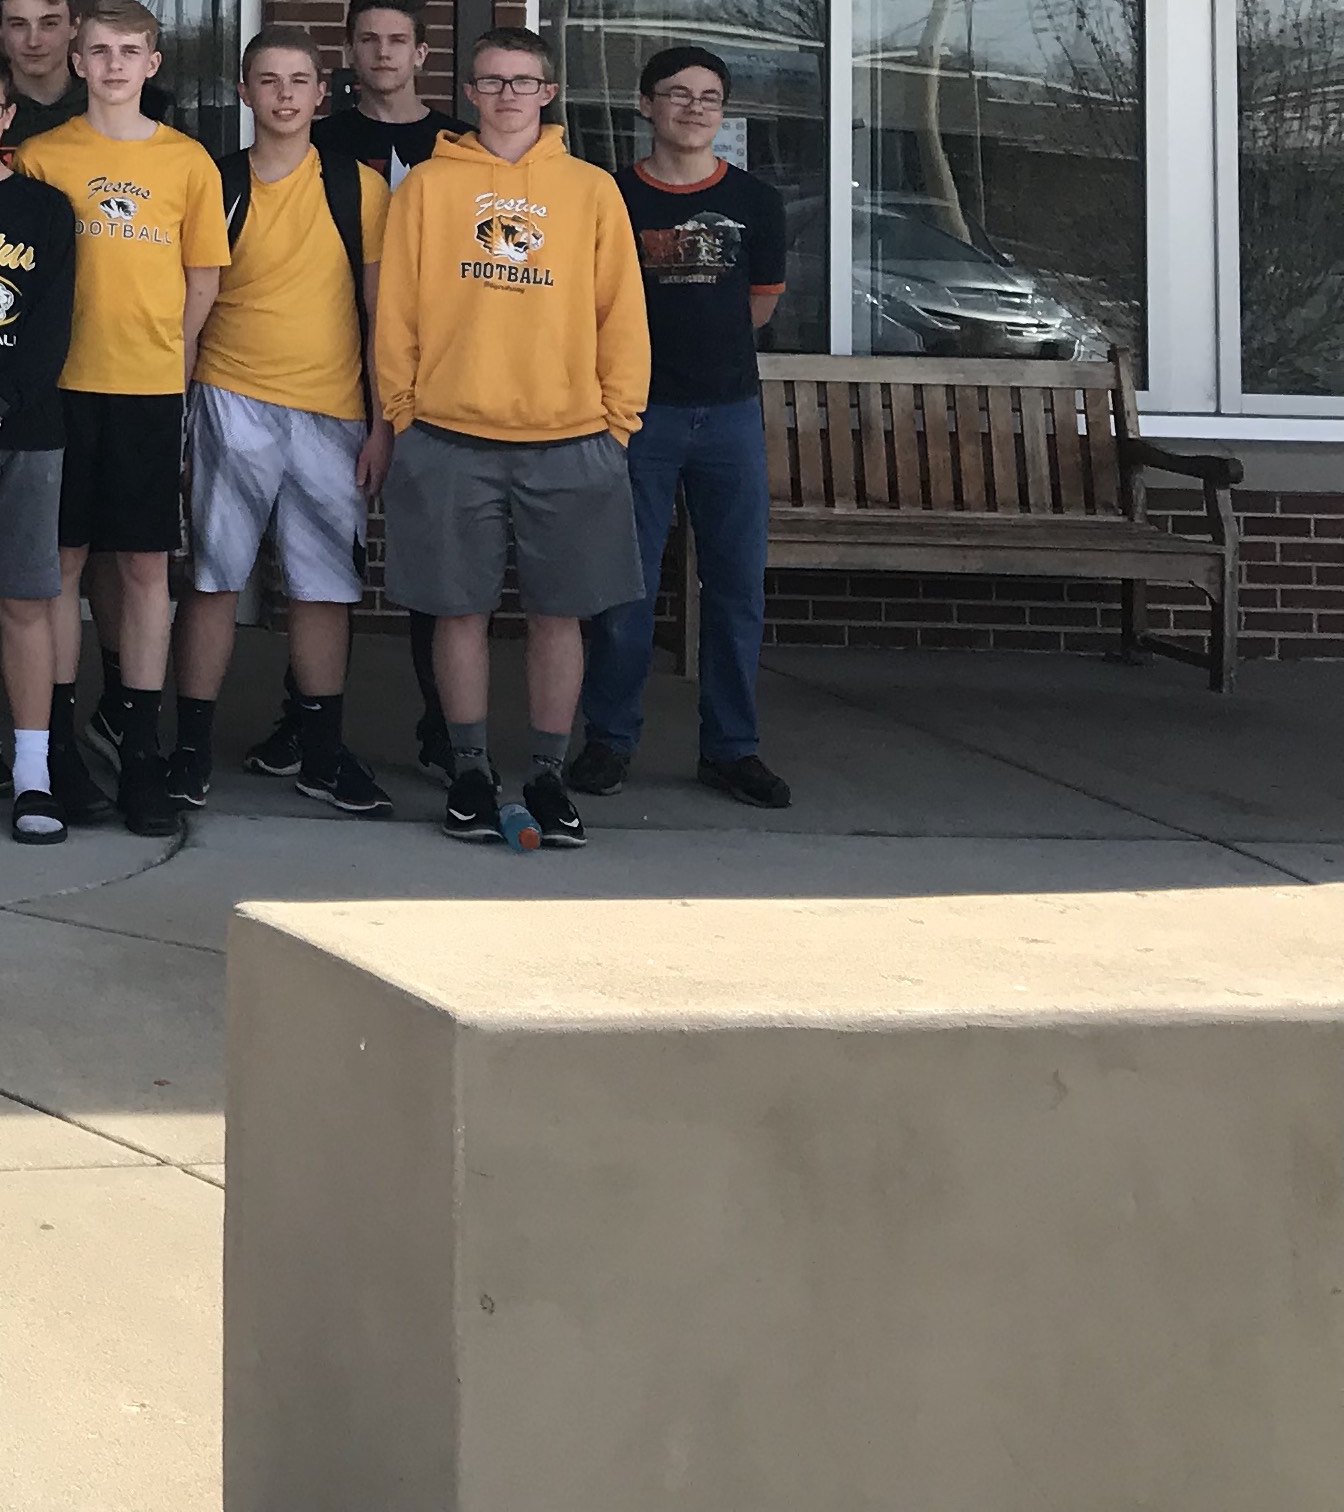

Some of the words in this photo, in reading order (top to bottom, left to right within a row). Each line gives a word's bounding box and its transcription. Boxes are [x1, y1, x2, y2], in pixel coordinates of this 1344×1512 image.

[87, 175, 152, 200] Festus
[474, 191, 549, 218] Festus
[75, 220, 173, 245] OOTBALL
[460, 261, 555, 287] FOOTBALL
